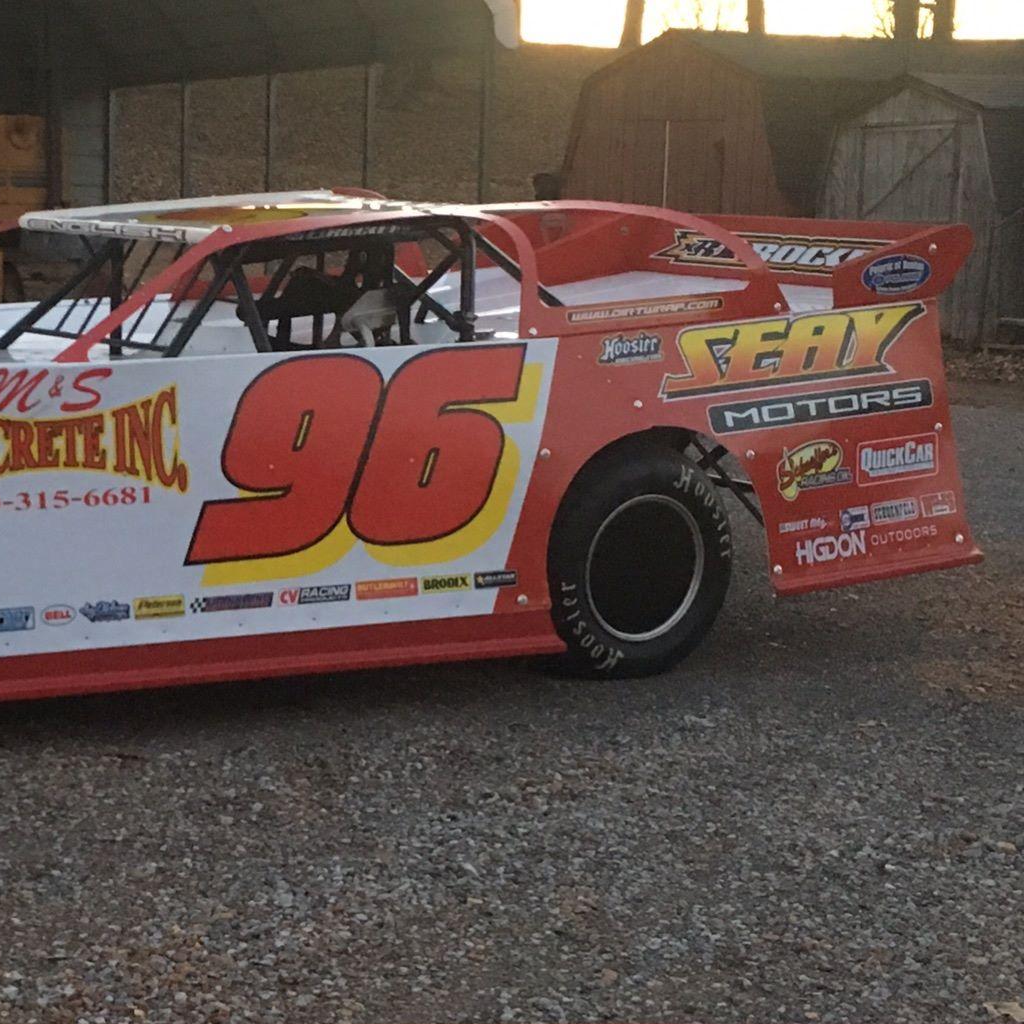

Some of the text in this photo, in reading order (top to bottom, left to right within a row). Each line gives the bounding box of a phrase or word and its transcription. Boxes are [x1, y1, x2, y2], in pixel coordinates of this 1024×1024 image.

[600, 334, 658, 361] Hoosier
[662, 303, 925, 394] SEAY
[725, 385, 924, 428] MOTORS
[112, 385, 189, 494] INC.
[183, 342, 531, 568] 96
[795, 525, 938, 565] HIGDON OUTDOORS
[423, 576, 469, 591] BRODIX
